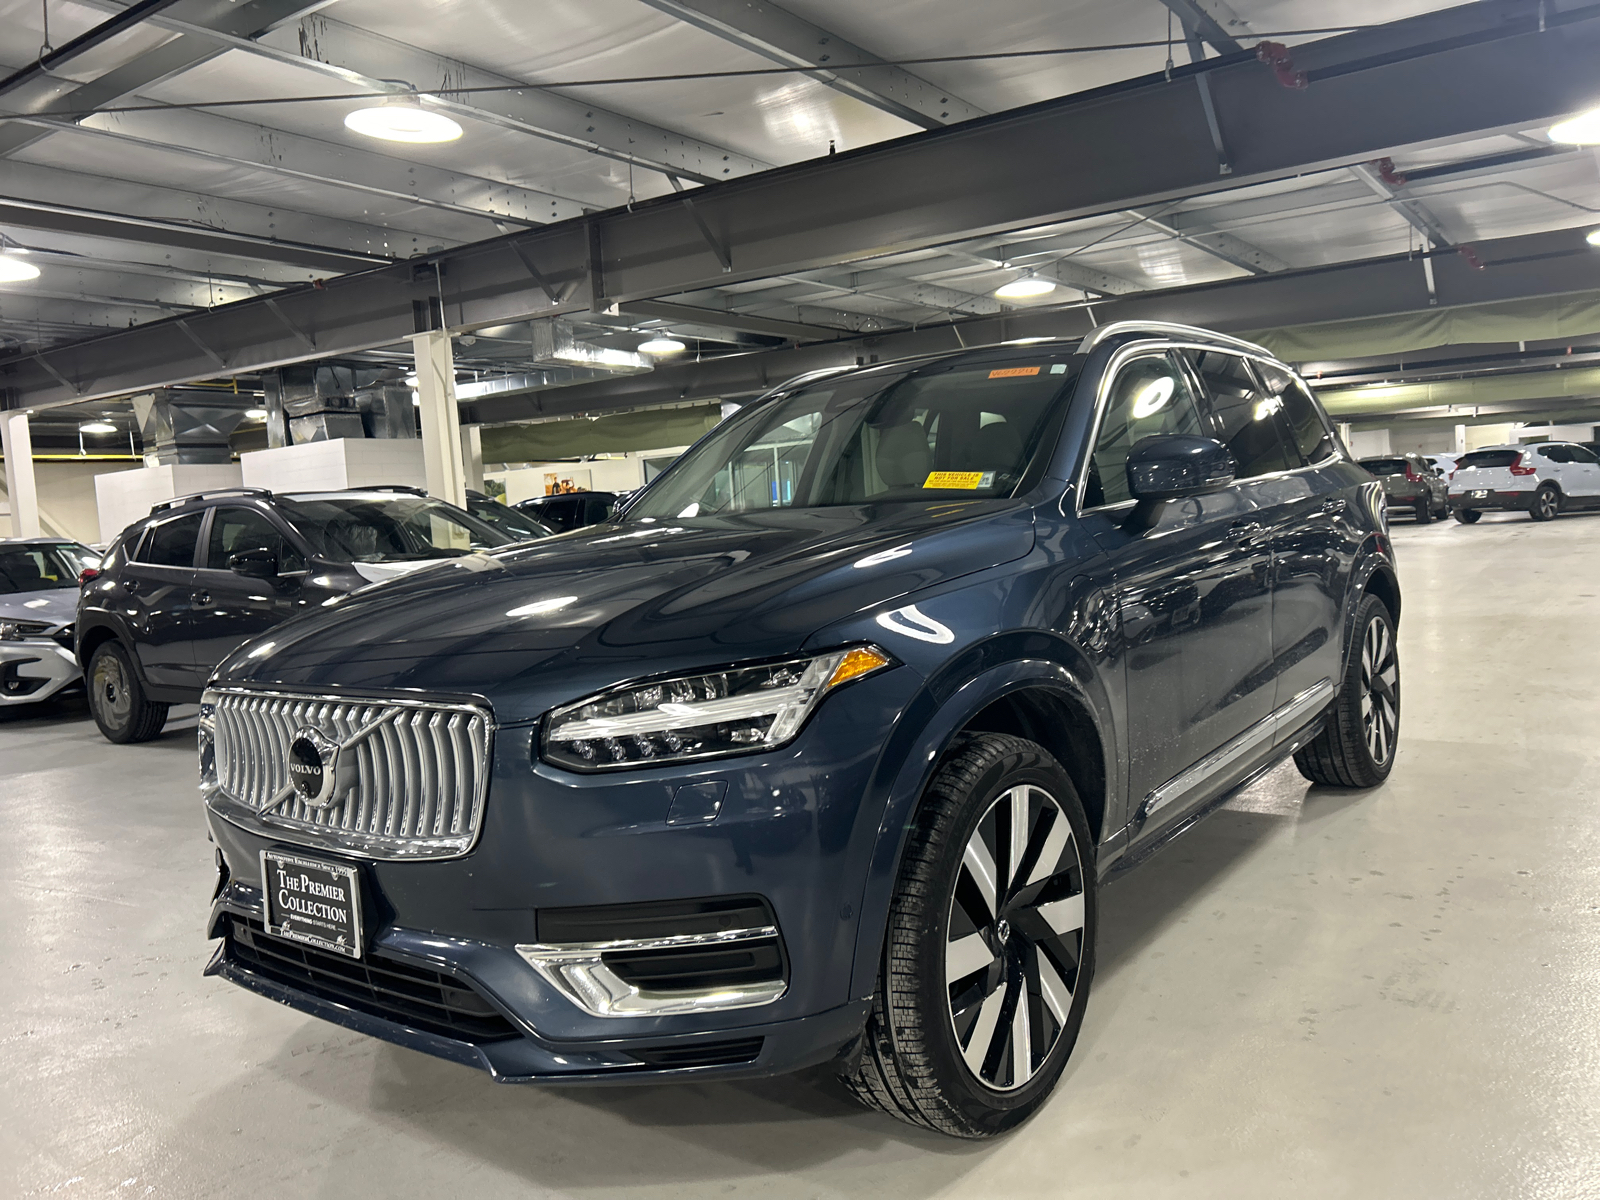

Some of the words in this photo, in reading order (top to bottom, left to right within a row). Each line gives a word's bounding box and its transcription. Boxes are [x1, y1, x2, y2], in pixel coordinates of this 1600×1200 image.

[291, 763, 321, 775] VOLVO
[277, 869, 300, 891] THE
[300, 874, 345, 902] PREMIER
[279, 889, 347, 923] COLLECTION
